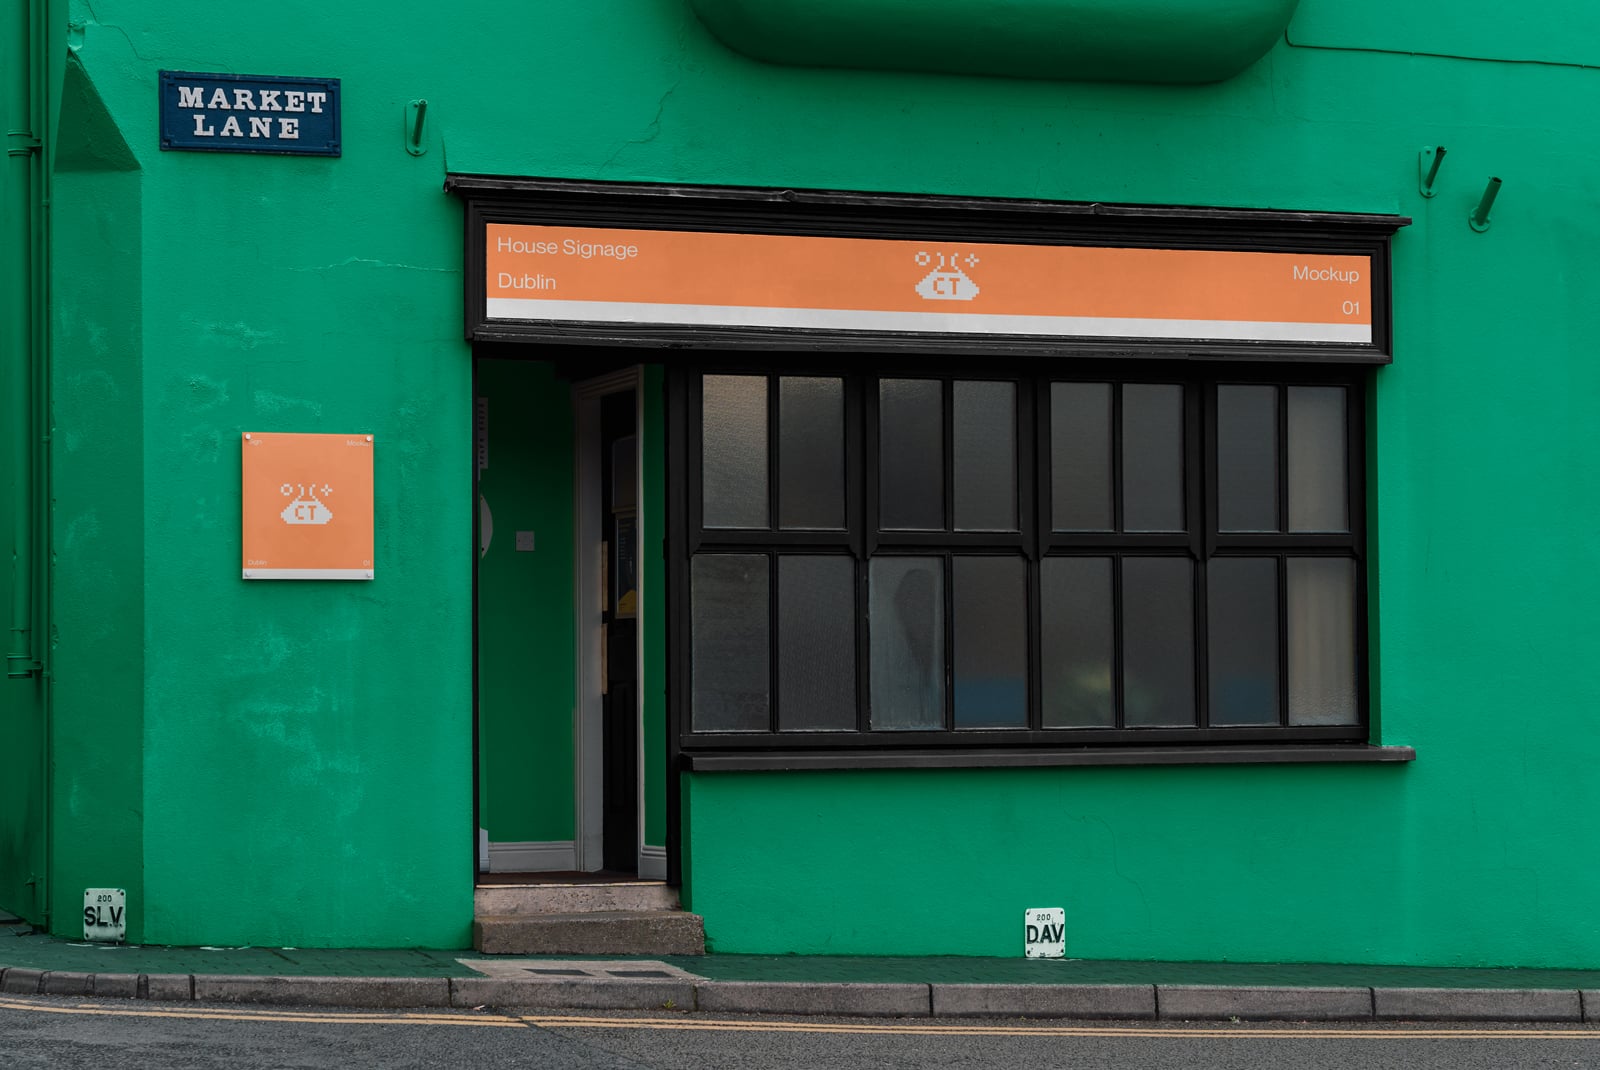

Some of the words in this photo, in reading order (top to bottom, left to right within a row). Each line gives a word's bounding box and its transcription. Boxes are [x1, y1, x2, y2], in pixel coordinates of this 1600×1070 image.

[178, 86, 327, 114] MARKET
[193, 114, 299, 139] LANE
[497, 236, 558, 255] House
[562, 239, 639, 260] Signage
[498, 272, 557, 290] Dublin
[1293, 265, 1360, 285] Mockup
[933, 277, 961, 296] CT
[1342, 300, 1360, 315] 01
[346, 439, 370, 447] Mocku
[295, 505, 317, 521] CT
[248, 559, 267, 567] Dublin
[97, 894, 112, 902] 200
[1036, 913, 1051, 922] 200
